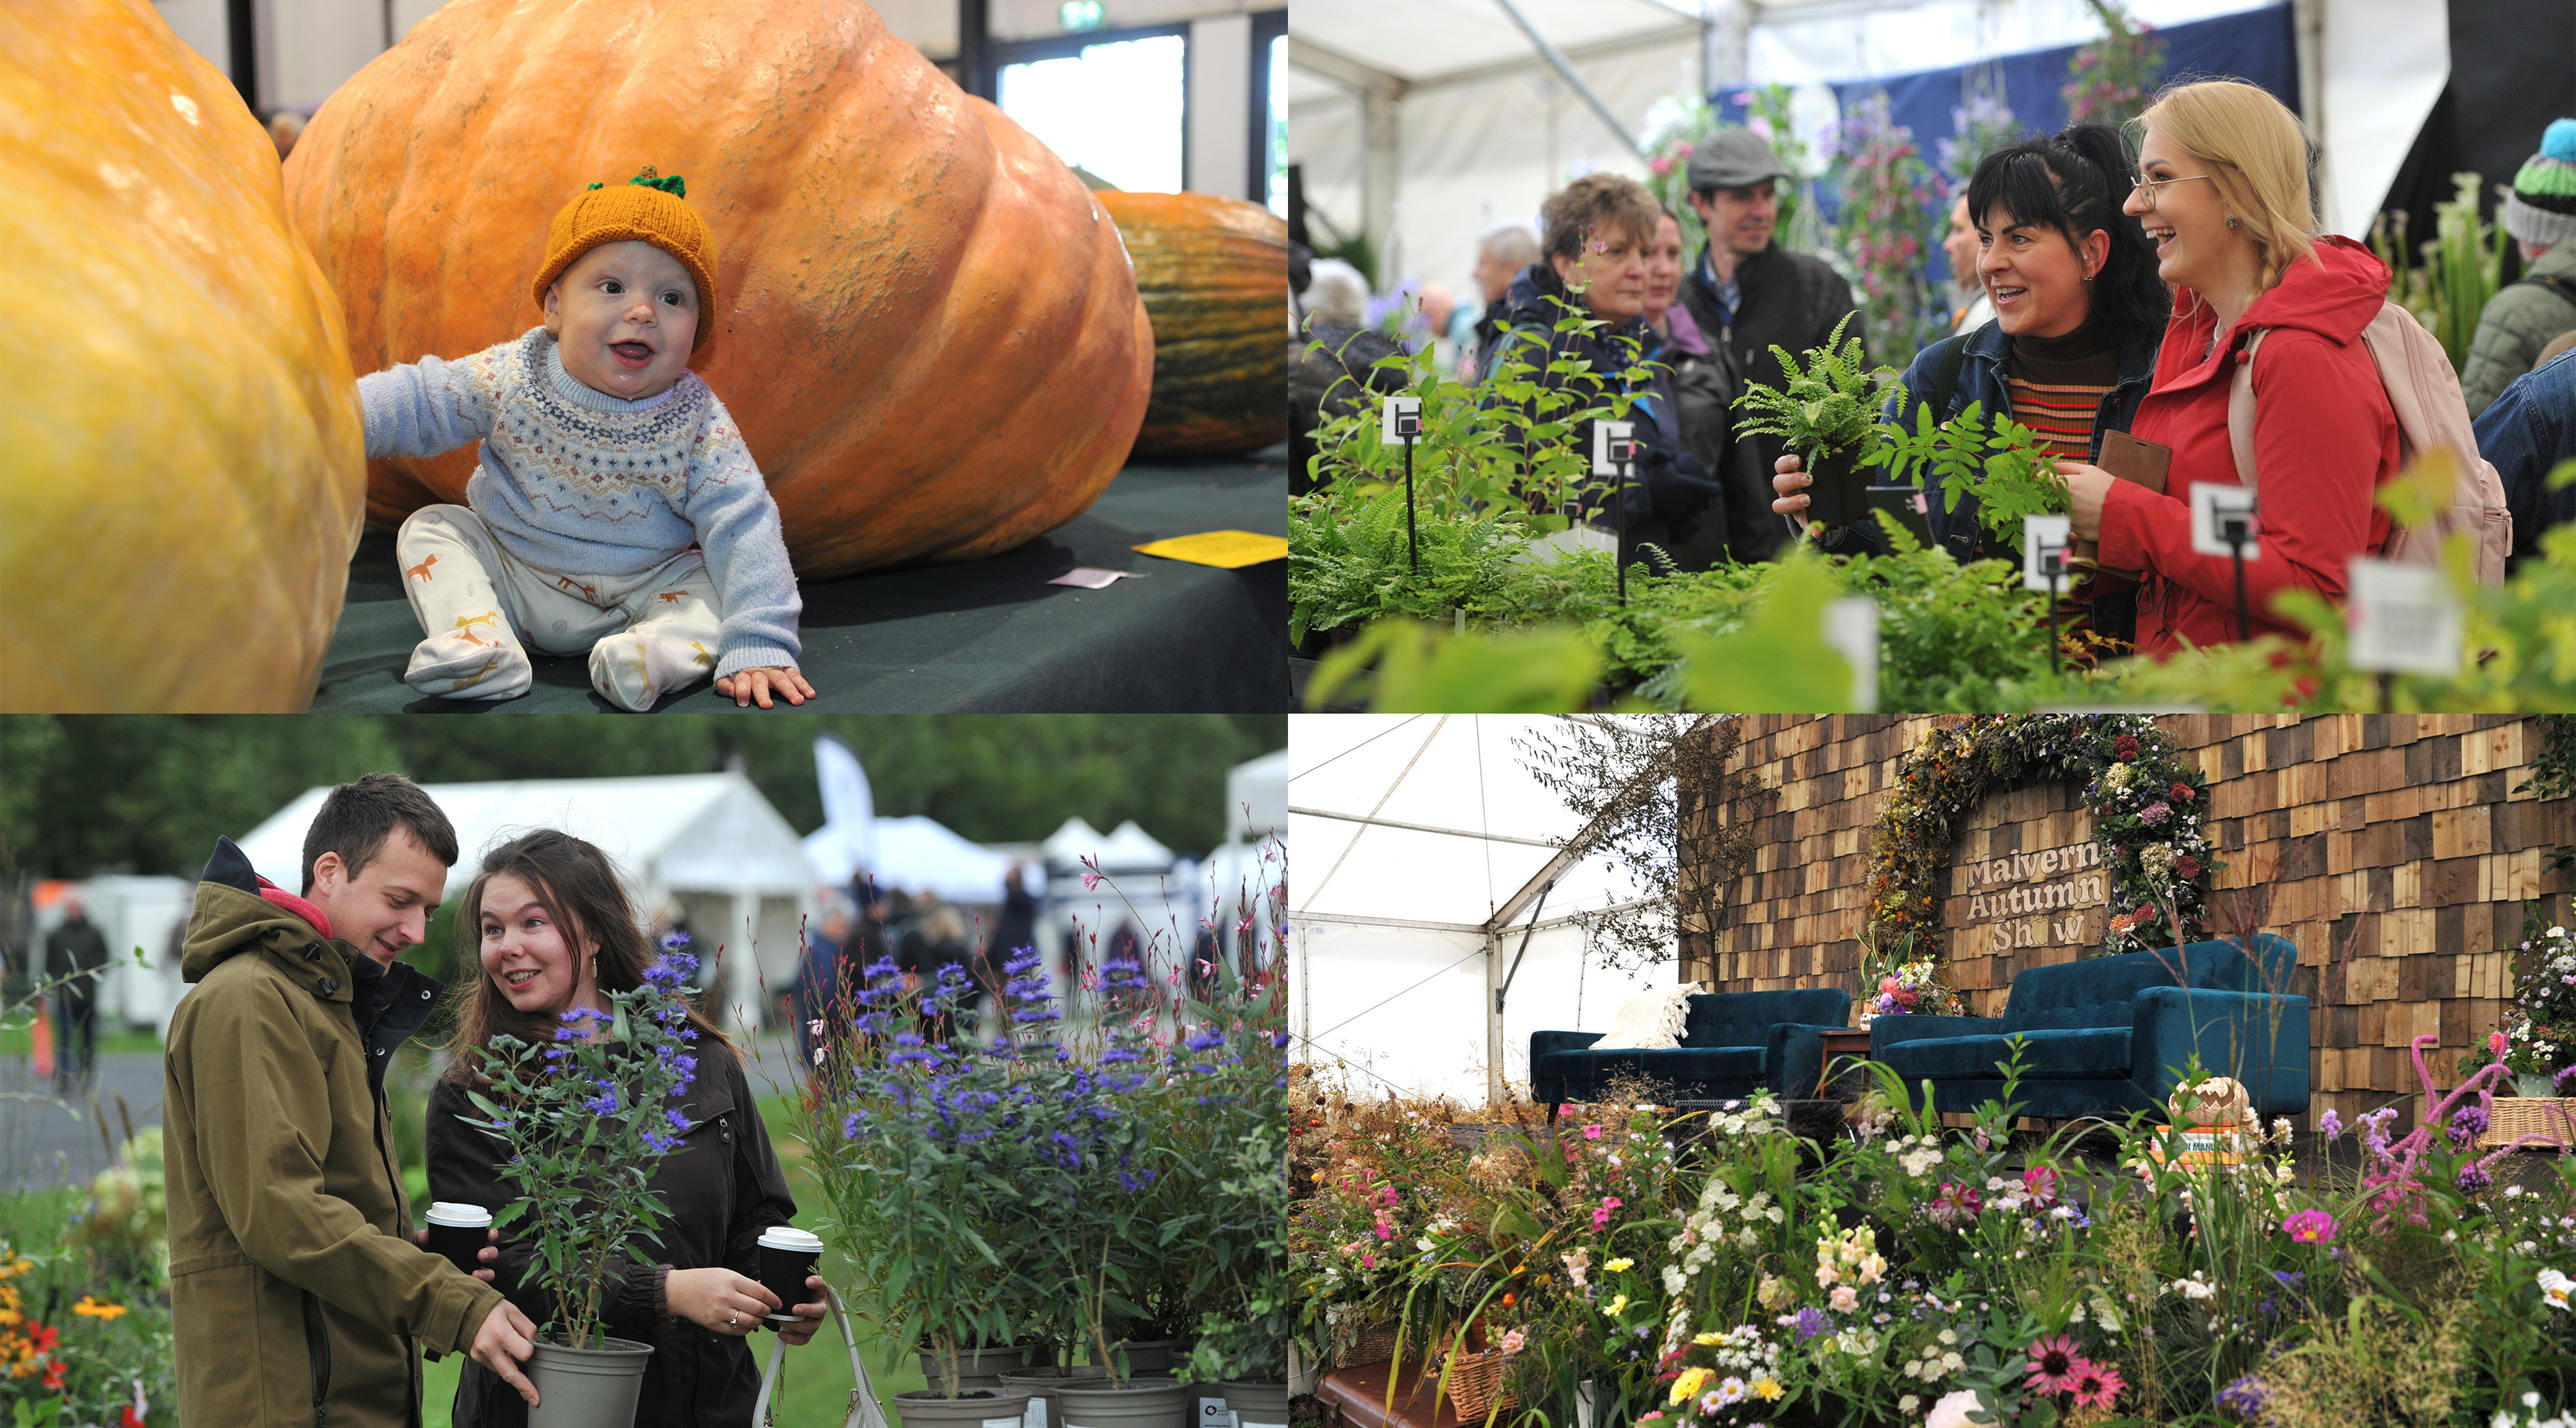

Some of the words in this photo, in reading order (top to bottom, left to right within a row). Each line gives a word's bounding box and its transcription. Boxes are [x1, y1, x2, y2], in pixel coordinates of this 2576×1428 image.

[1964, 841, 2101, 888] Malvern
[1966, 875, 2103, 921] Autumn
[2192, 1142, 2221, 1152] MANU
